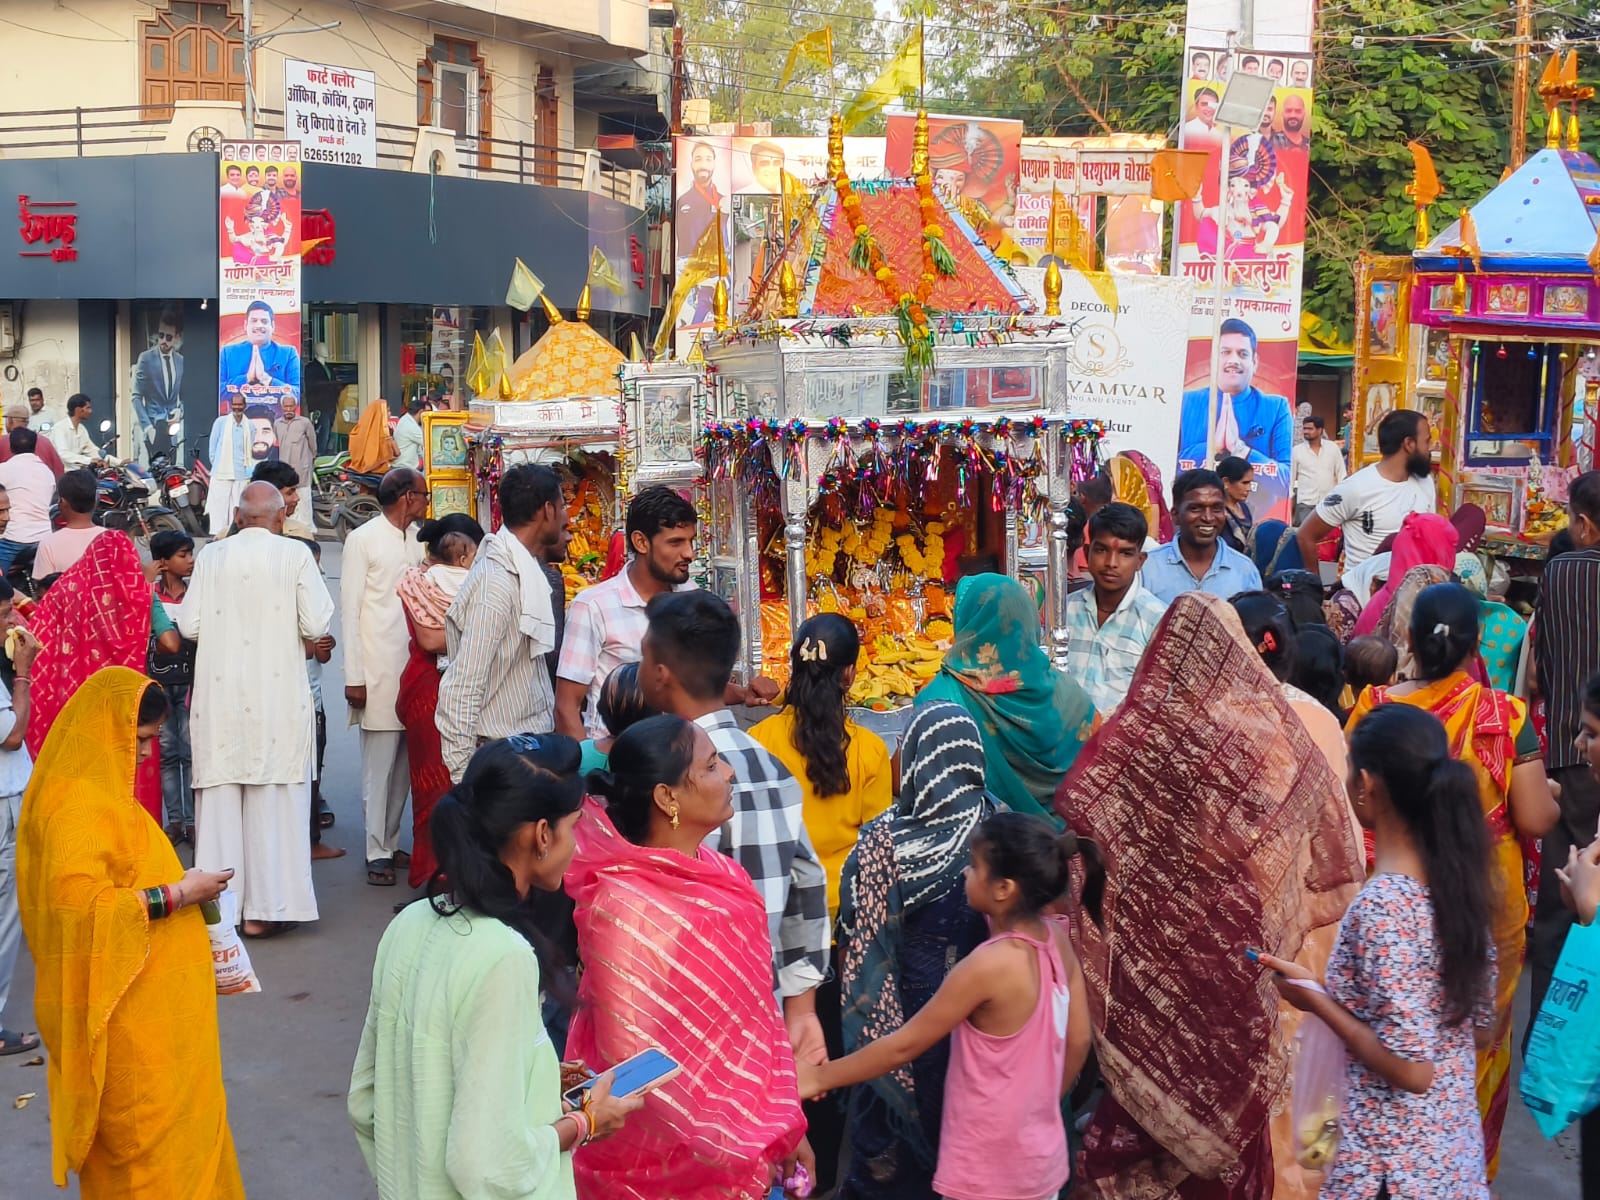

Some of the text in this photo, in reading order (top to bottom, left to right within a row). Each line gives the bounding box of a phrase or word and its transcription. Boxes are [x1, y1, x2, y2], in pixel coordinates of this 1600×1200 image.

[331, 70, 355, 88] फ्लोर
[352, 96, 374, 115] दुकान
[296, 110, 310, 134] हेतु
[345, 116, 359, 135] देना
[1021, 159, 1050, 183] परशुराम
[1082, 157, 1152, 186] परशुराम चौराह
[1071, 301, 1130, 314] DECOR BY
[1067, 380, 1167, 404] YAMVAR
[1108, 419, 1132, 433] kur
